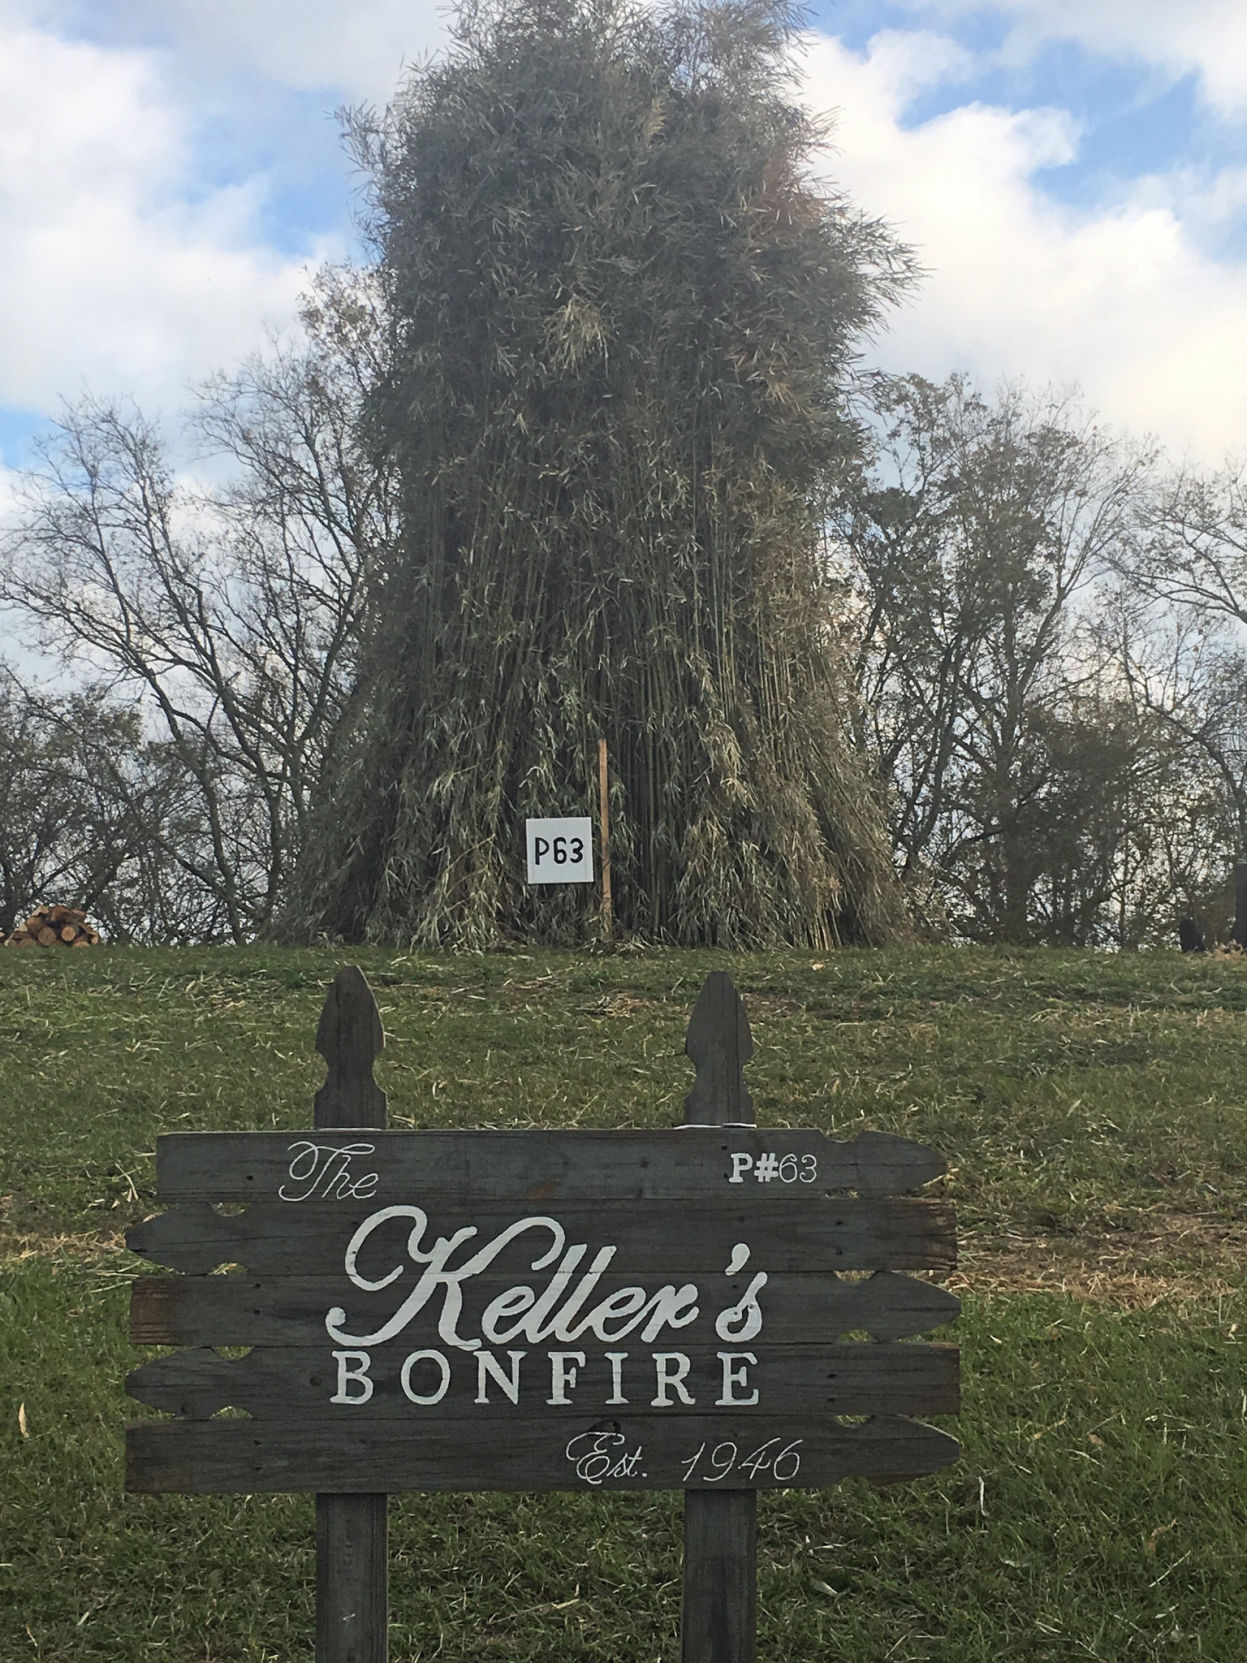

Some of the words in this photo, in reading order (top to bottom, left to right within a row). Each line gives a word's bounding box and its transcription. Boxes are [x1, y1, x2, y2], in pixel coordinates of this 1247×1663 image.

[534, 836, 584, 865] P63
[278, 1140, 379, 1202] The
[729, 1152, 818, 1184] P#63
[325, 1204, 767, 1351] Keller's
[330, 1350, 760, 1406] BONFIRE
[566, 1430, 648, 1484] Est.
[681, 1436, 804, 1482] 1946
